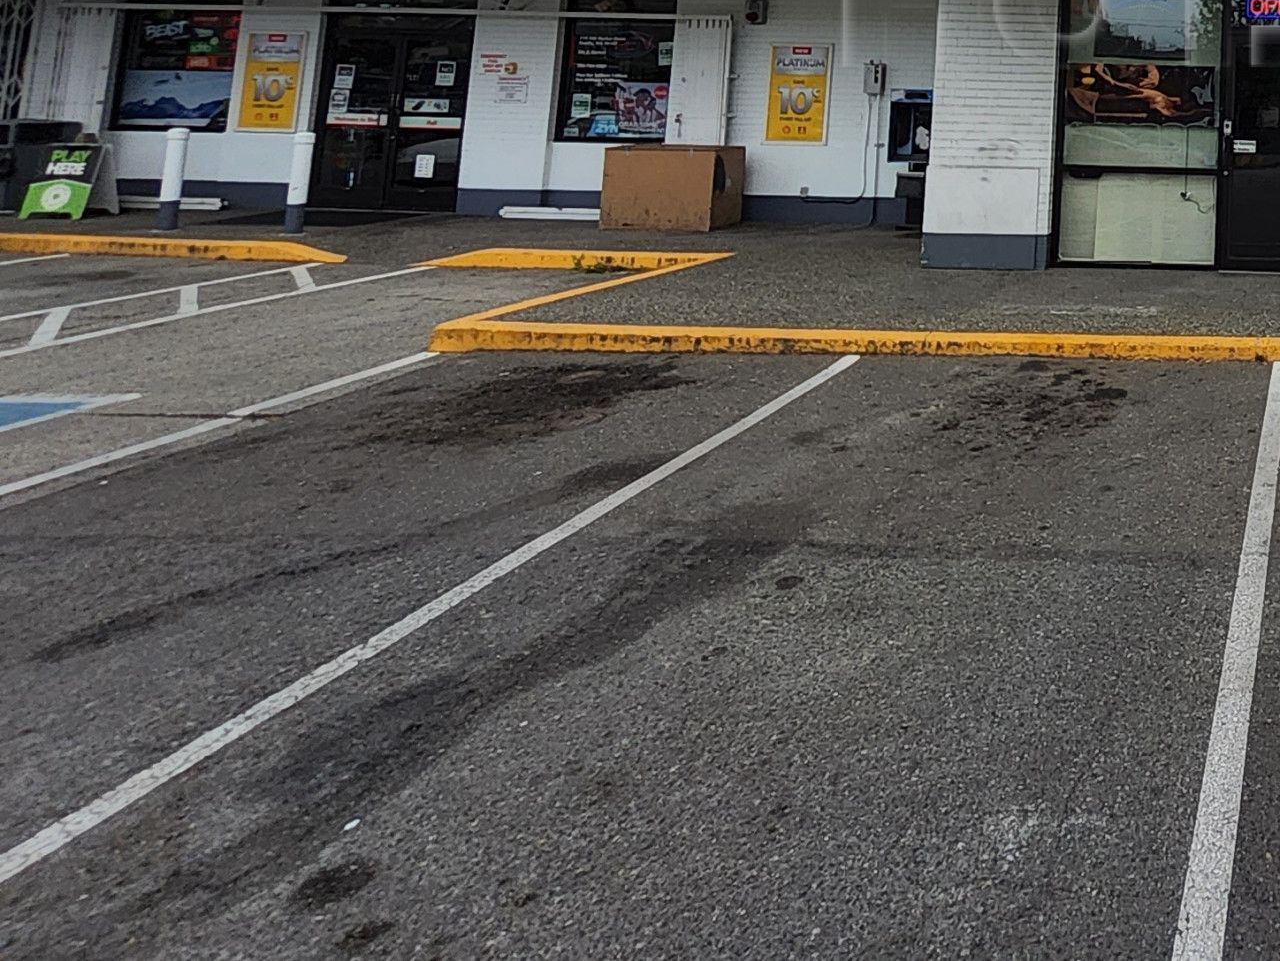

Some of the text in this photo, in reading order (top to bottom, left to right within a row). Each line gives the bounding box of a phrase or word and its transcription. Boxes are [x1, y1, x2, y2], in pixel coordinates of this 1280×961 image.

[776, 58, 825, 68] PLATINUM
[595, 124, 619, 134] ZYN
[51, 149, 92, 162] PLAY
[45, 162, 87, 175] HERE
